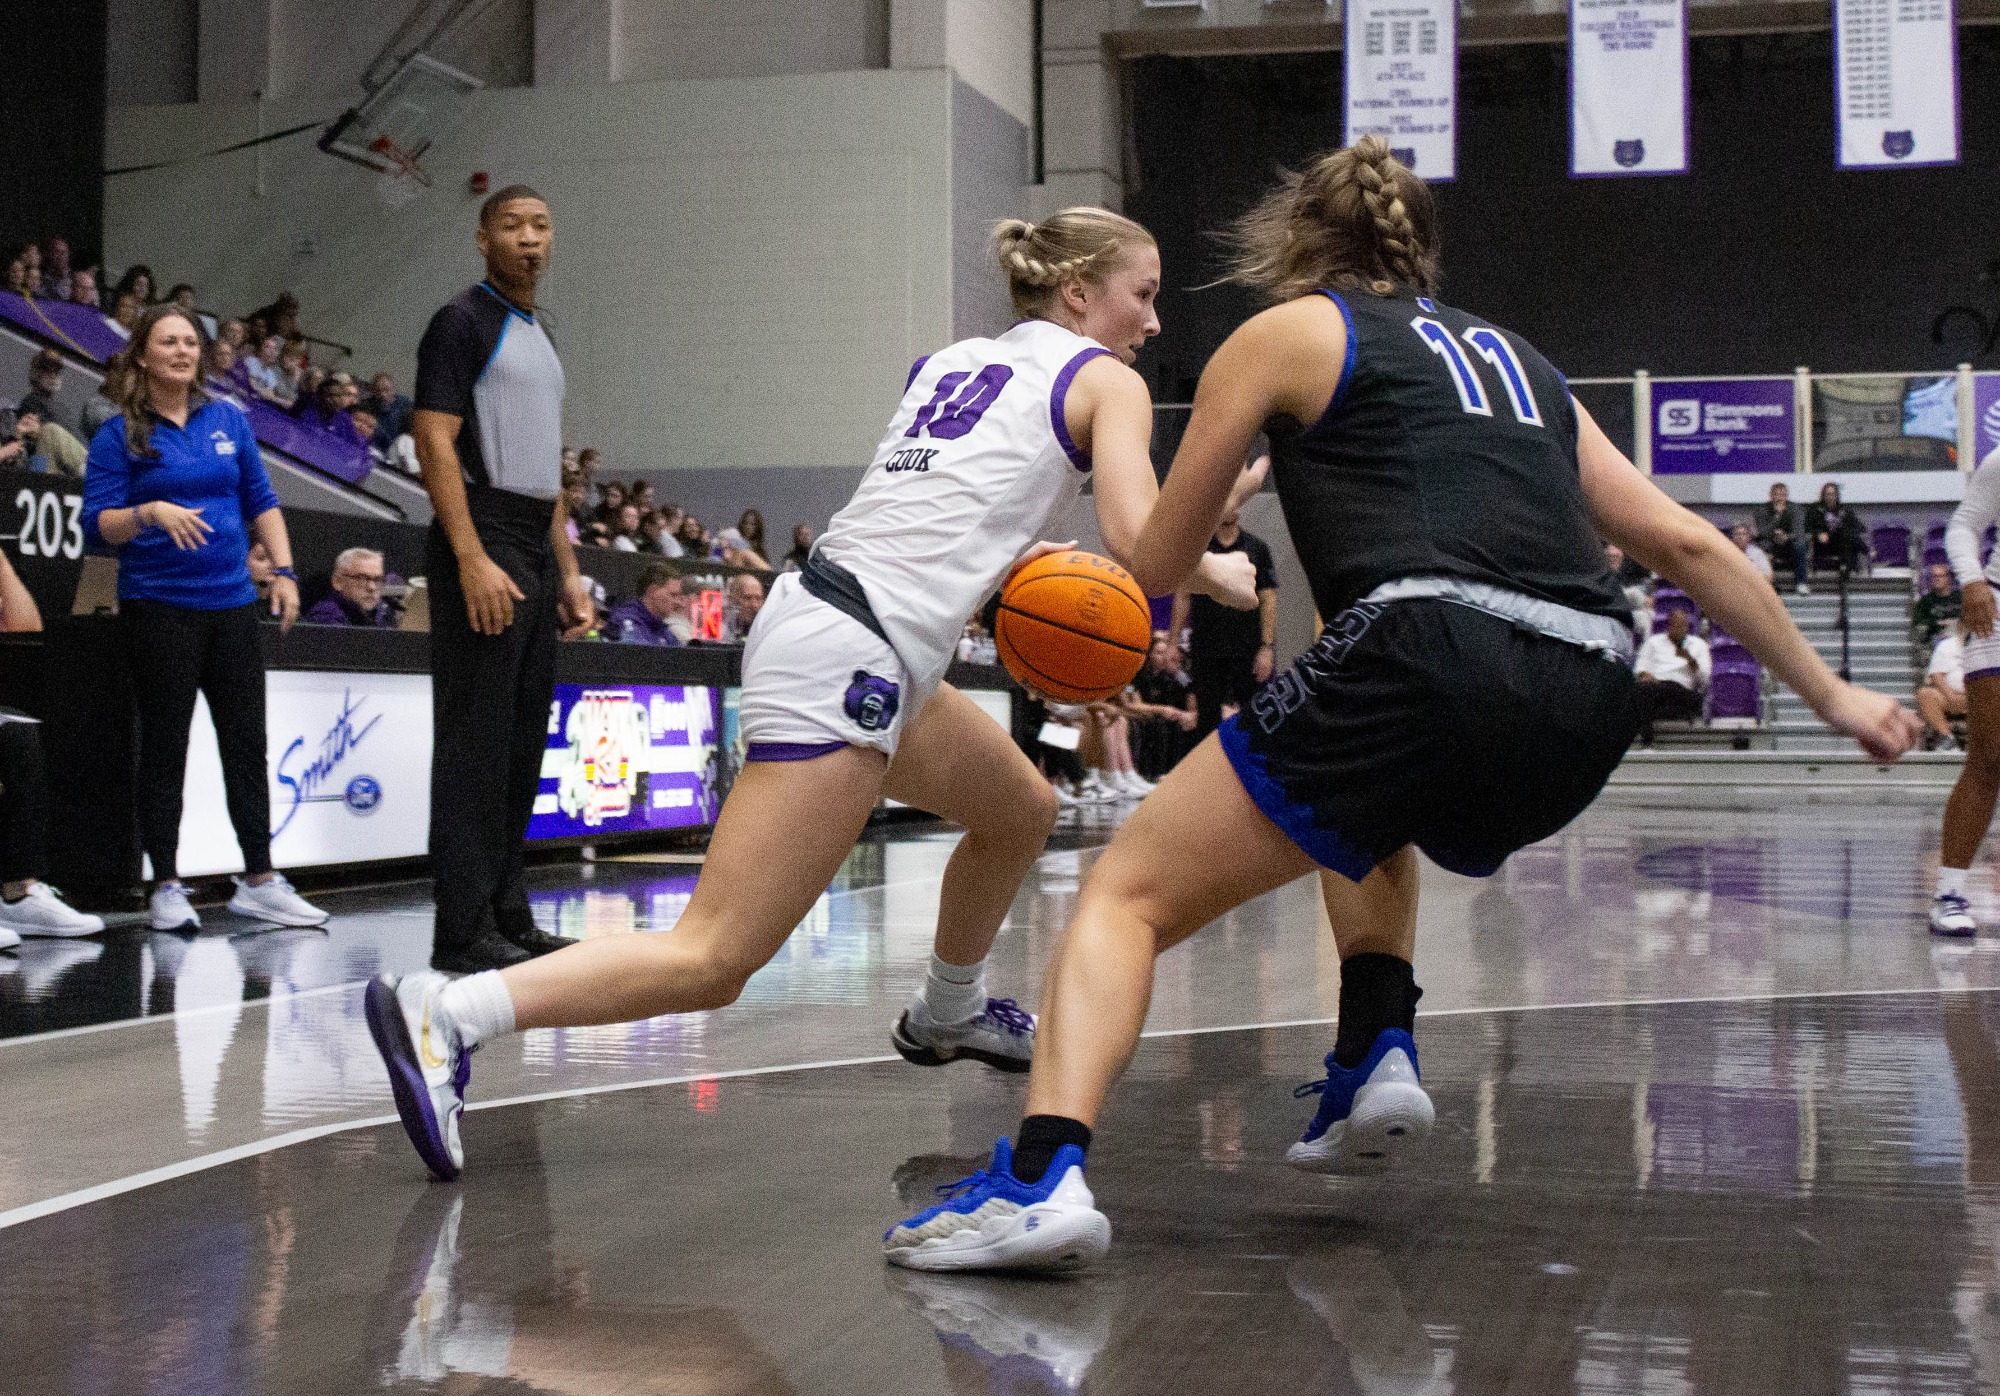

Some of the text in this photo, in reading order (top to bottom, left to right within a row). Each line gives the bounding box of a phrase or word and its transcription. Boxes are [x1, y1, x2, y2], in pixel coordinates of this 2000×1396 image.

[903, 363, 1014, 441] 10
[1409, 315, 1545, 428] 11
[885, 448, 940, 473] COOK
[15, 488, 84, 560] 203
